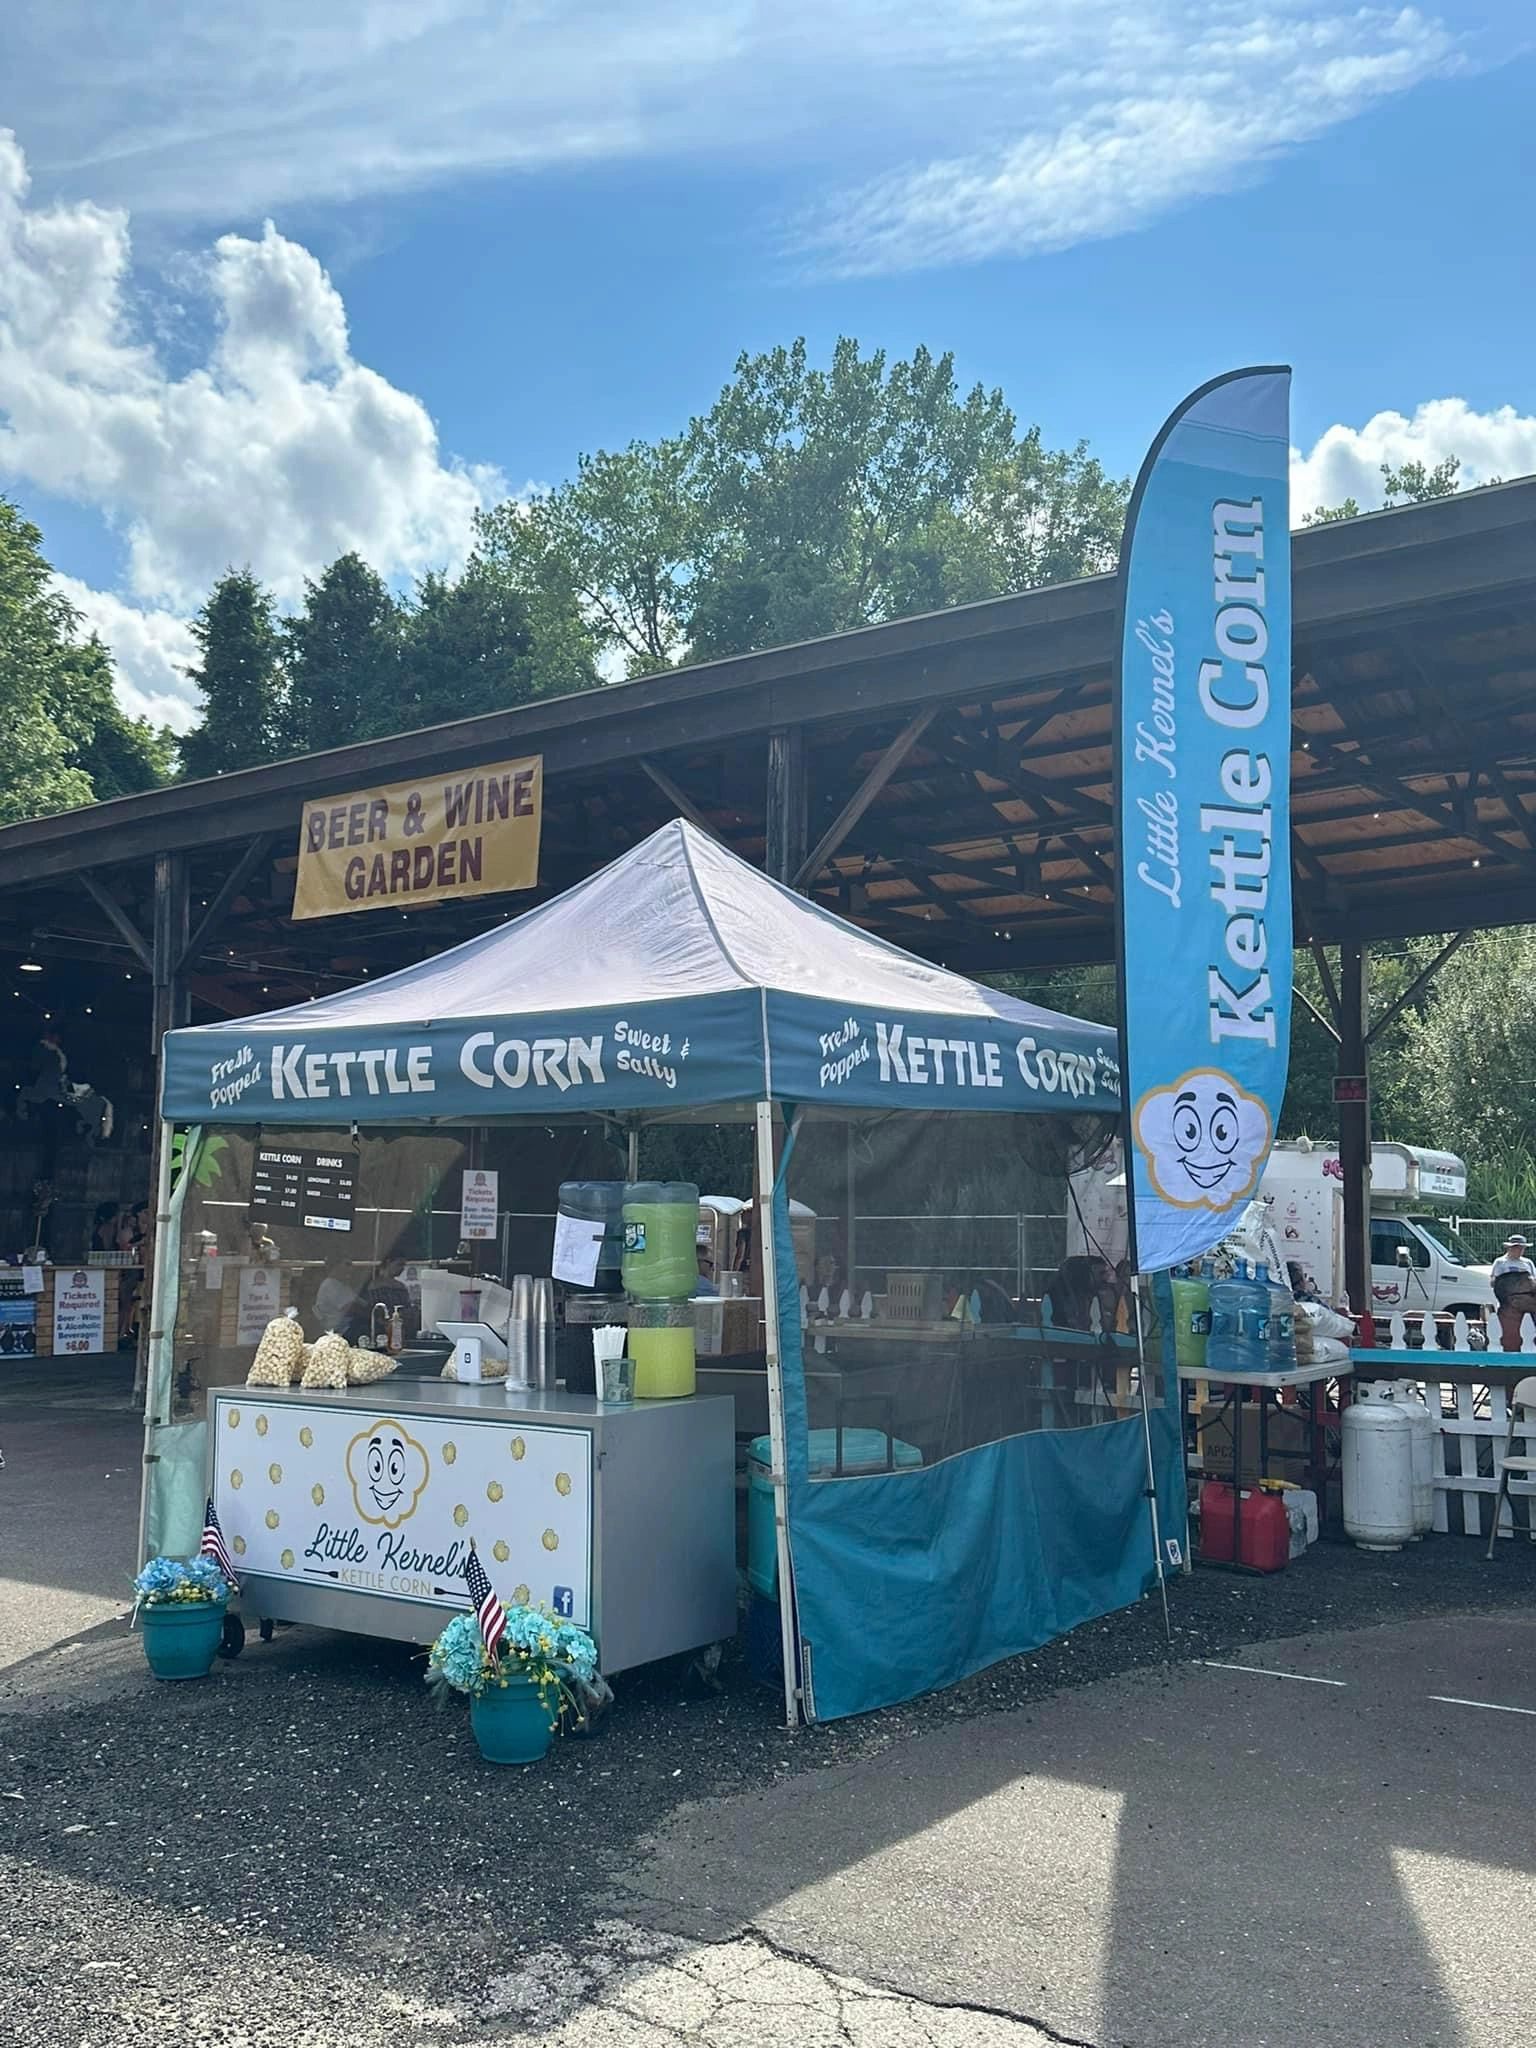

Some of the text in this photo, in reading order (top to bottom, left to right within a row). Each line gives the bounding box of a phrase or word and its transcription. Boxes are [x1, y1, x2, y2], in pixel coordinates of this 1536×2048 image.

[1135, 607, 1181, 908] Little Kernel's
[1198, 496, 1276, 1048] Kettle Corn
[306, 769, 534, 853] BEER & WINE
[344, 836, 482, 901] GARDEN
[614, 1021, 690, 1060] Sweet &
[819, 1017, 860, 1057] Fresh
[211, 1045, 254, 1084] Fresh
[271, 1031, 606, 1099] KETTLE CORN
[617, 1049, 676, 1088] Salty
[820, 1038, 870, 1088] Popped
[875, 1022, 1095, 1098] KETTLE CORN
[210, 1062, 262, 1110] Popped
[259, 1152, 302, 1164] KETTLE CORN
[316, 1157, 343, 1168] DRINKS
[59, 1300, 100, 1311] Required
[63, 1292, 96, 1300] Tickets
[57, 1314, 76, 1322] Beer
[58, 1331, 98, 1340] Beverages
[65, 1321, 101, 1330] Alcoholic
[304, 1523, 468, 1578] Little Kernel's
[341, 1567, 431, 1596] KETTLE CORN
